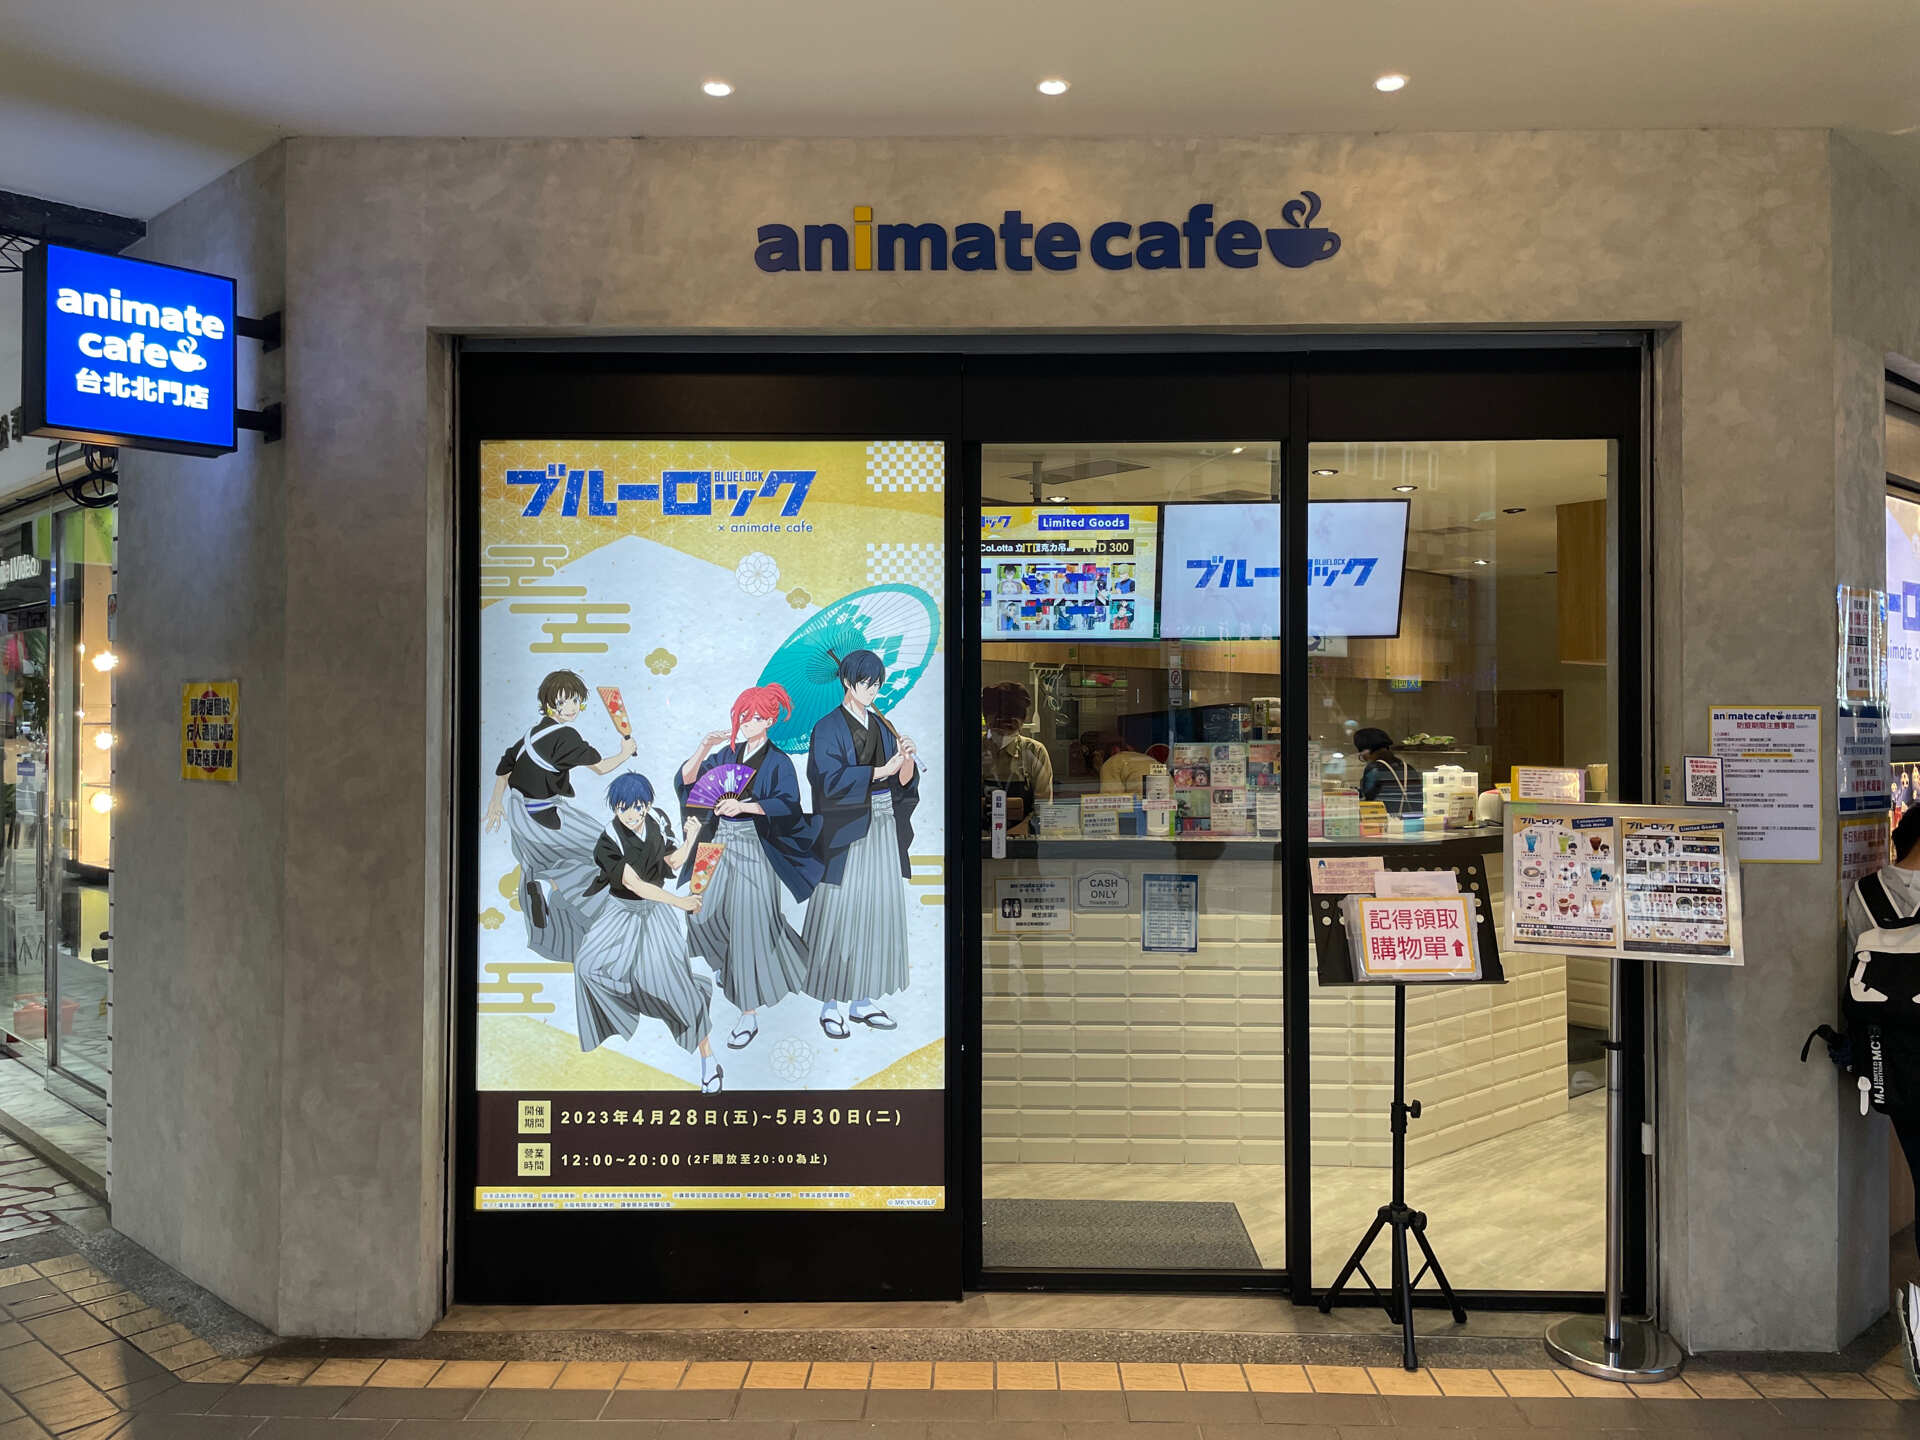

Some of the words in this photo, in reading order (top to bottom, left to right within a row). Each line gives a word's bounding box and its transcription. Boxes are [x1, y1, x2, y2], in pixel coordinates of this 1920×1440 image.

[754, 205, 1081, 272] animate
[1090, 203, 1262, 271] cafe
[57, 288, 225, 340] animate
[78, 332, 169, 369] cafe
[75, 367, 209, 410] 台北北門店
[713, 471, 765, 483] BLUELOCK
[505, 463, 817, 518] ブルーロック
[730, 521, 782, 534] animate
[786, 520, 814, 534] cafe
[1043, 517, 1085, 528] Limited
[1089, 517, 1125, 528] Goods
[1109, 542, 1129, 553] 300
[1713, 711, 1754, 721] animate
[1754, 711, 1776, 721] cafe
[1090, 879, 1118, 888] CASH
[1091, 890, 1117, 899] ONLY
[1369, 908, 1460, 931] 記得領取
[1371, 936, 1449, 961] 購物單
[1873, 1086, 1885, 1104] MJ
[524, 1105, 545, 1116] 開催
[524, 1118, 545, 1129] 期間
[524, 1148, 545, 1159] 營業
[524, 1161, 545, 1171] 時間
[561, 1154, 681, 1166] 12:00~20:00
